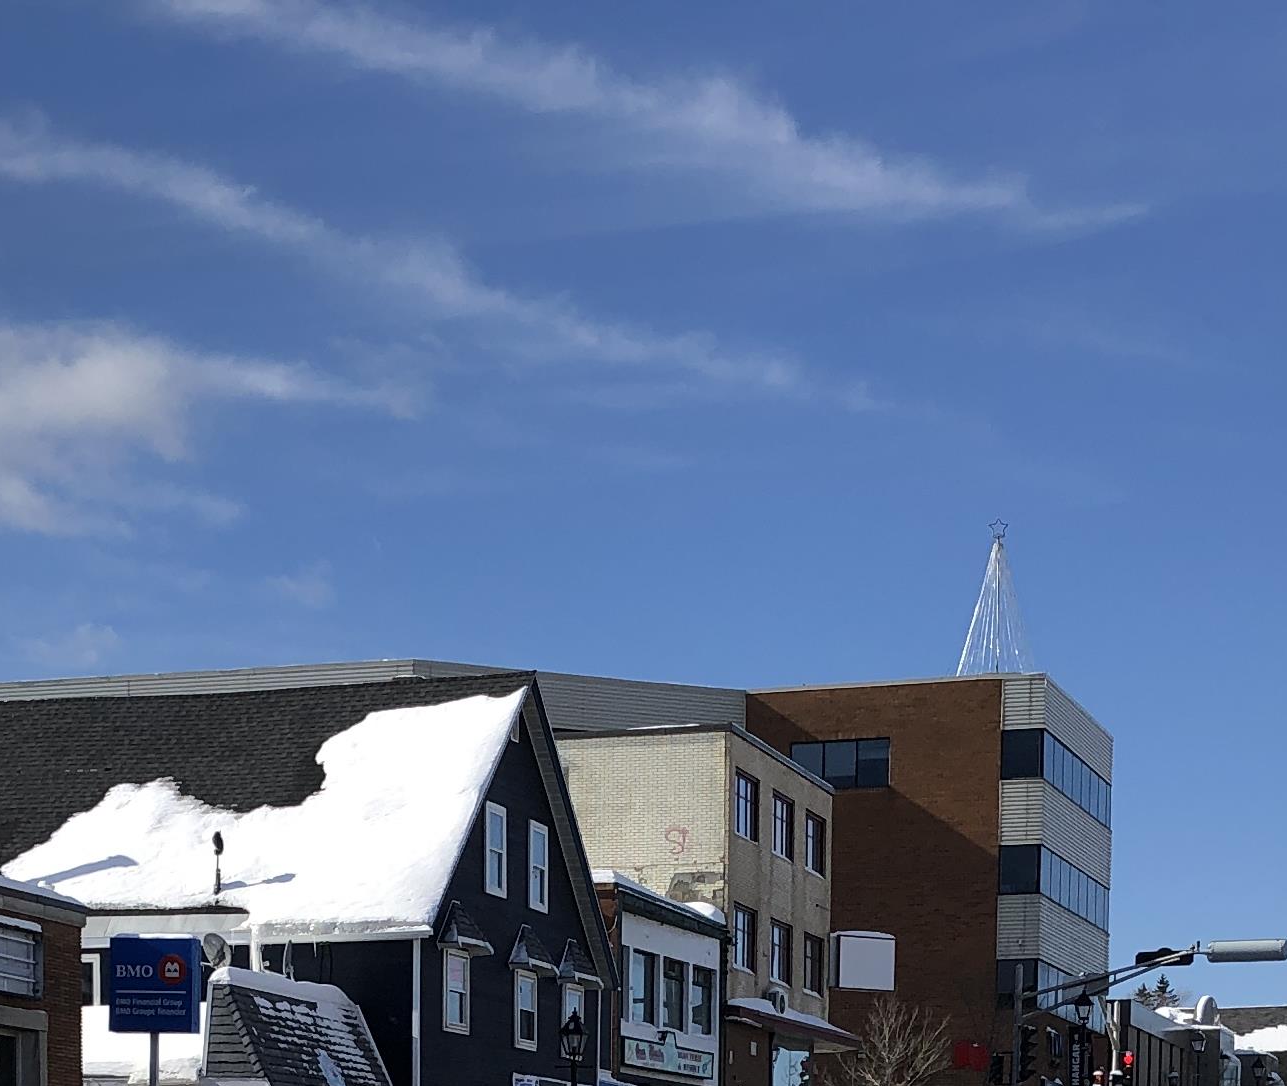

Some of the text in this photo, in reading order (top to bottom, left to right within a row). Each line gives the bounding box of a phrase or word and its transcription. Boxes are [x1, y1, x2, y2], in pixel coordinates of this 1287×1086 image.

[116, 964, 153, 977] BMO
[132, 997, 161, 1005] Financial
[162, 998, 183, 1008] Group
[132, 1007, 155, 1016] Groupe
[157, 1007, 186, 1015] financier
